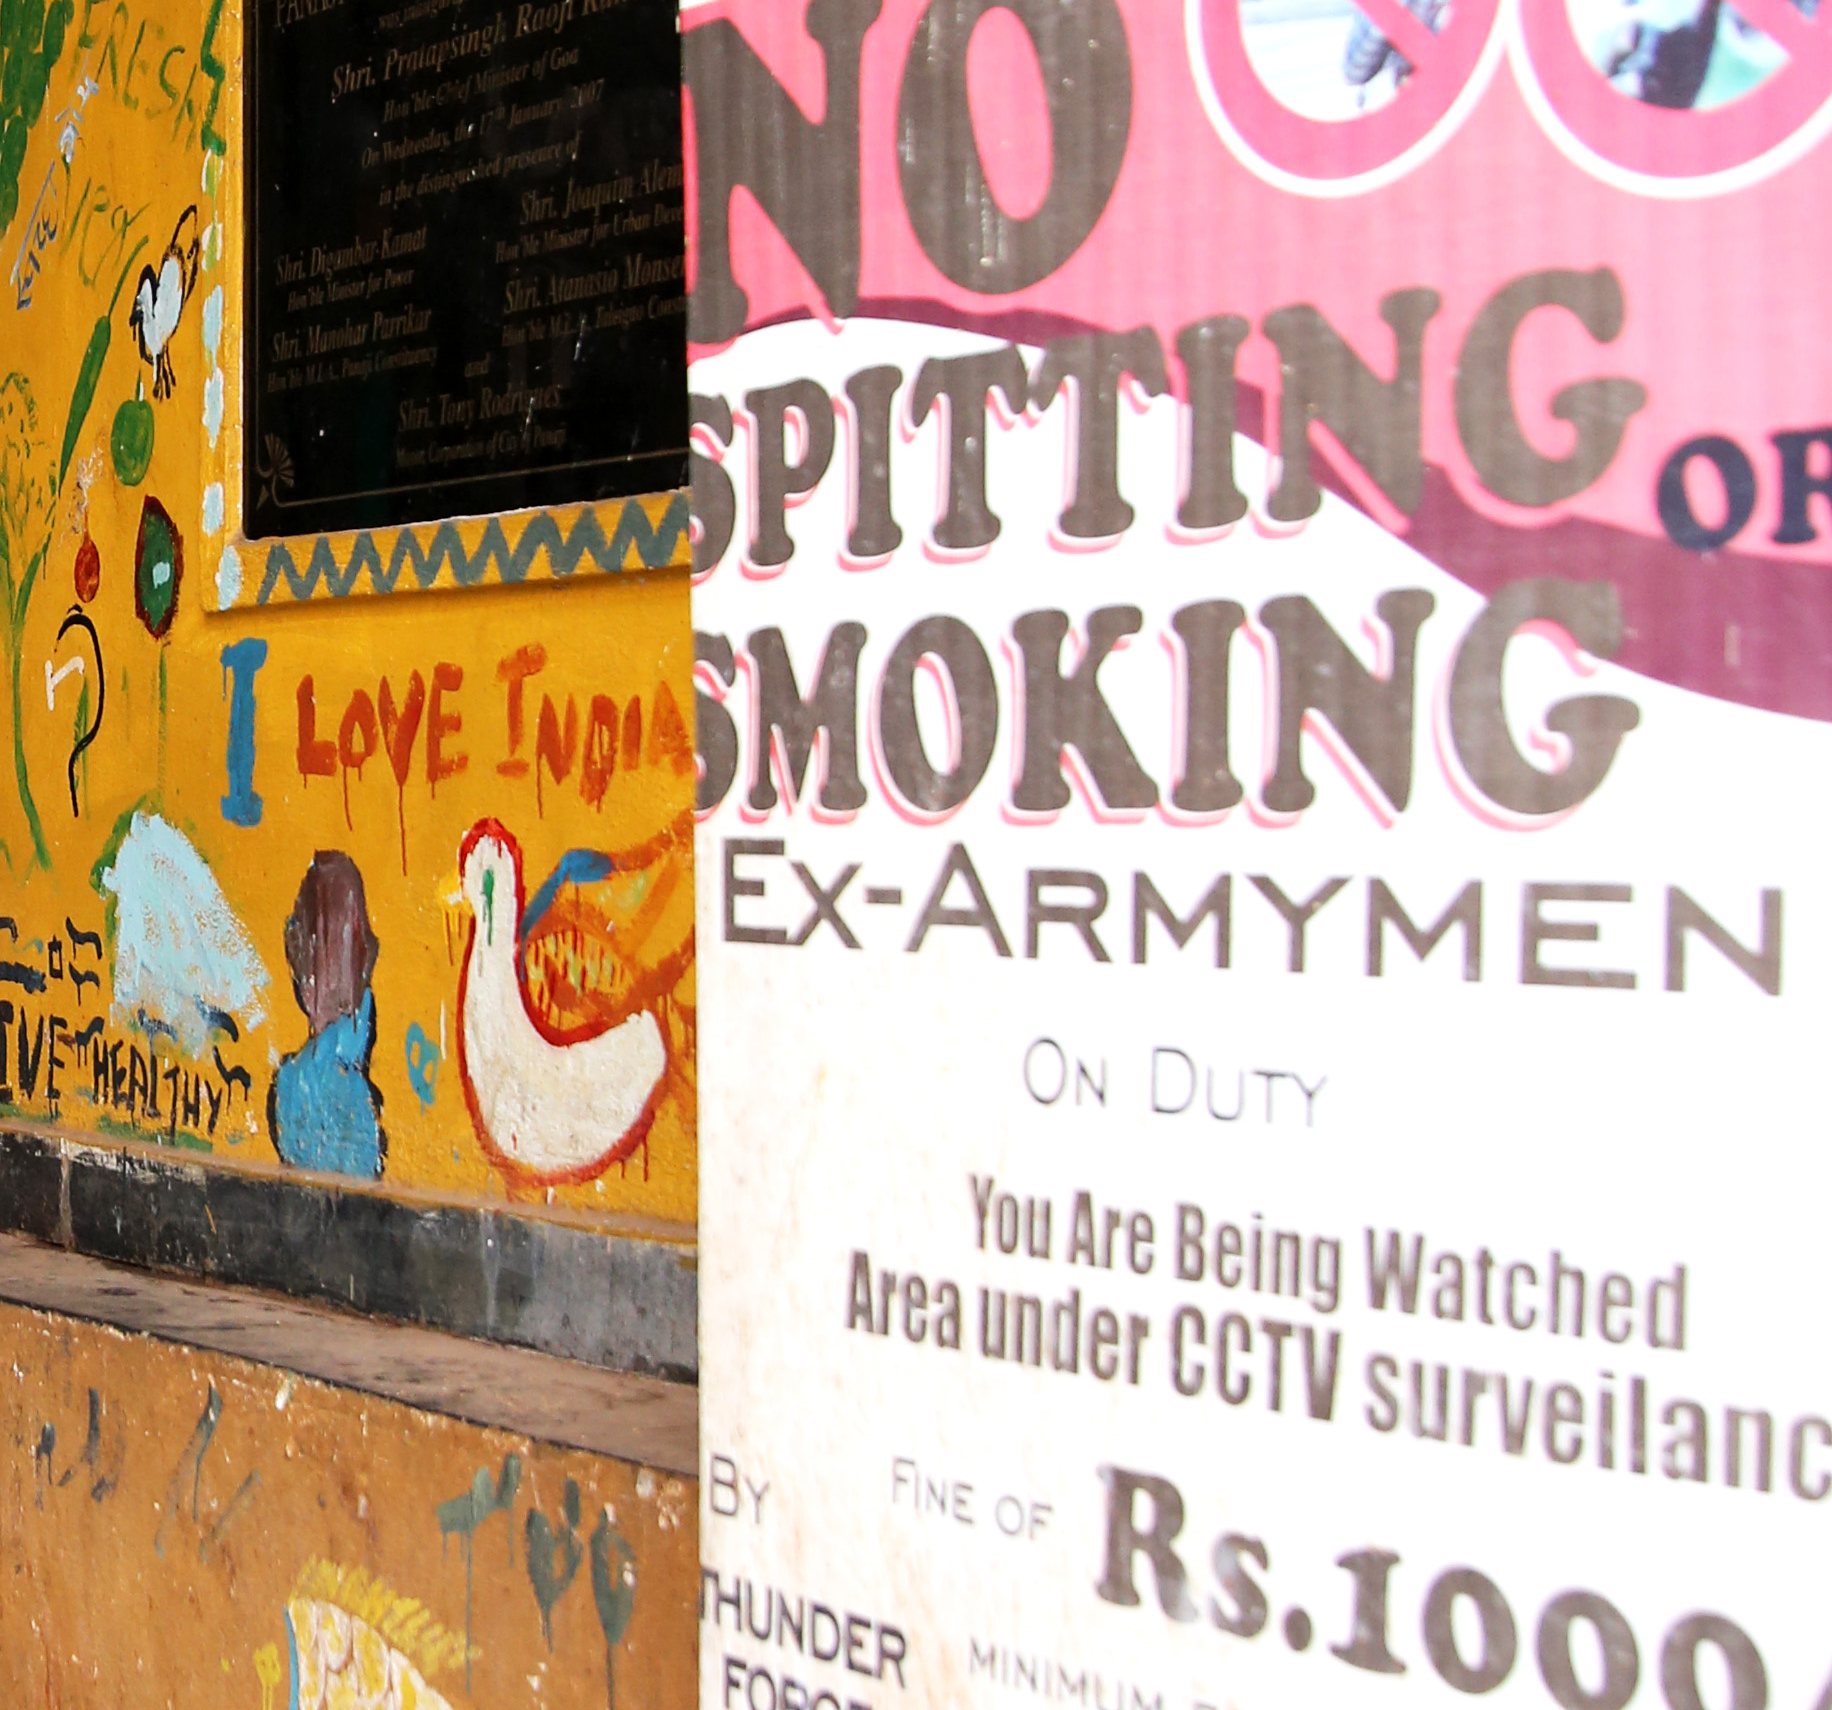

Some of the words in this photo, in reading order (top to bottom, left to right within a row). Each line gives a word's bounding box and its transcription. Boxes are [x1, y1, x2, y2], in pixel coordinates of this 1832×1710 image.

[332, 63, 377, 98] Shri.
[383, 11, 506, 82] Pratapsingh
[549, 44, 580, 72] Goa
[688, 265, 1649, 580] SPITTING
[220, 637, 267, 827] I
[296, 661, 468, 800] LOVE
[495, 641, 693, 812] INDIA
[695, 576, 1642, 831] SMOKING
[93, 1034, 222, 1140] HEALTHY
[970, 1173, 1053, 1260] You
[1066, 1191, 1156, 1276] Are
[1174, 1203, 1342, 1315] Being
[1364, 1226, 1690, 1351] Watched
[846, 1250, 963, 1351] Area
[977, 1286, 1152, 1385] under
[1169, 1305, 1342, 1424] CCTV
[708, 1451, 770, 1527] BY
[892, 1456, 975, 1525] FINE
[995, 1494, 1054, 1543] OF
[699, 1568, 908, 1690] THUNDER
